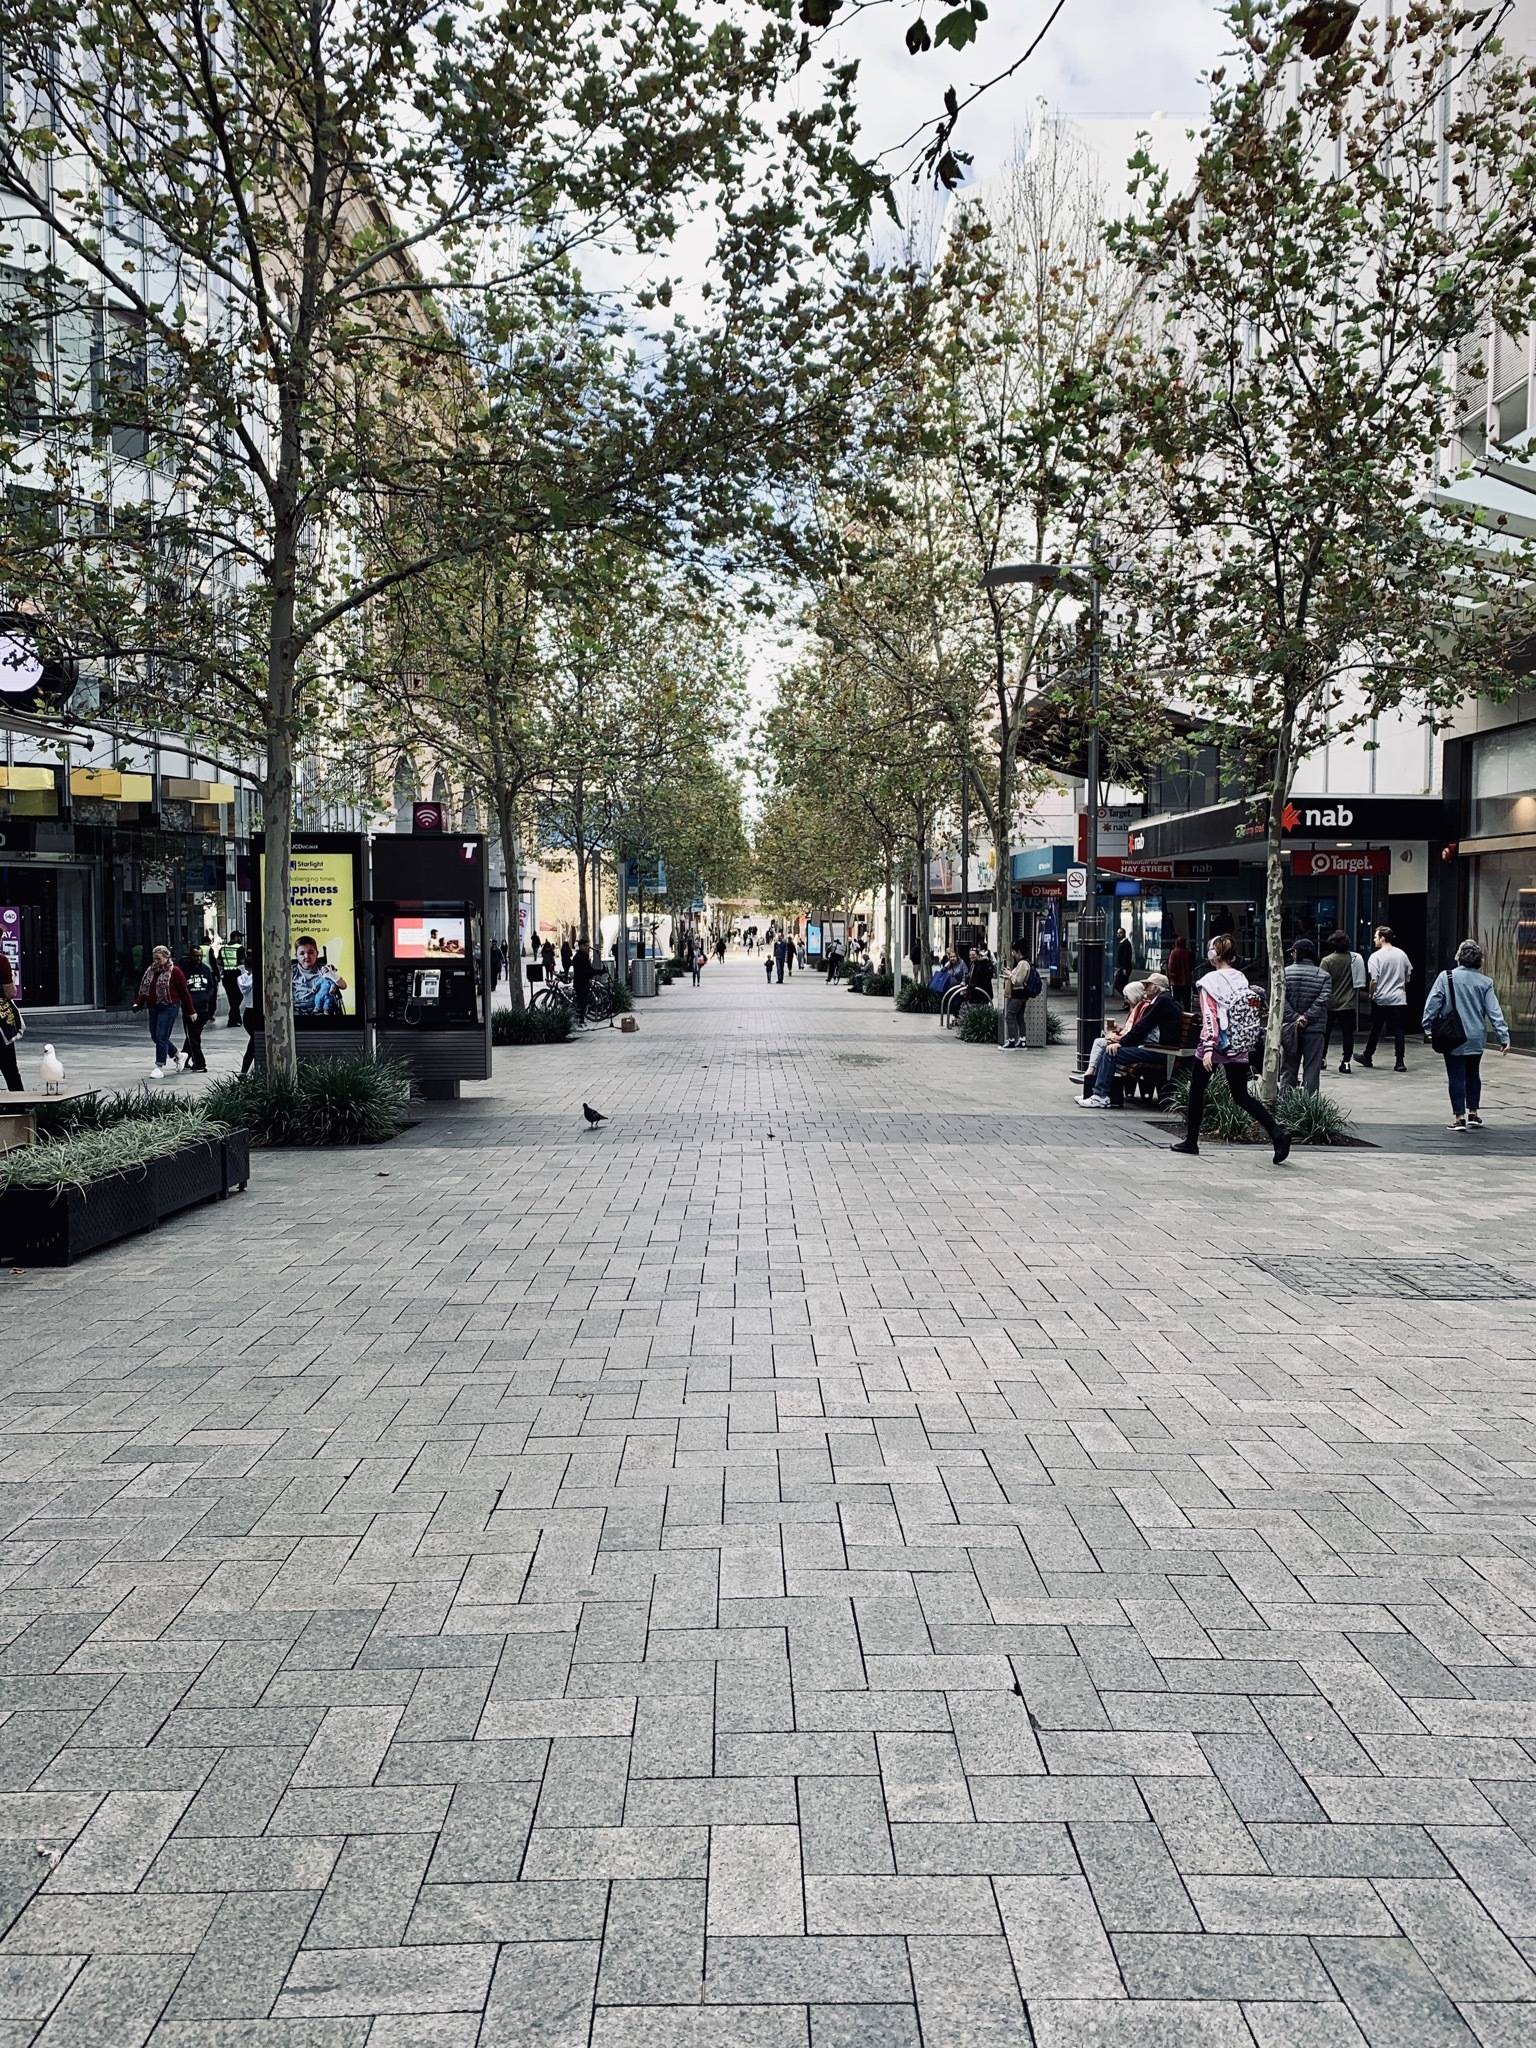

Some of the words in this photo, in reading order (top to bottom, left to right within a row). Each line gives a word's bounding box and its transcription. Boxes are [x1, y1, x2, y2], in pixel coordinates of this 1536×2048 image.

[1305, 804, 1353, 827] nab
[1113, 823, 1129, 831] nab
[1134, 832, 1145, 850] nab
[462, 842, 478, 859] T
[1121, 865, 1138, 873] HAY
[1140, 865, 1173, 873] STREET
[1192, 865, 1213, 873] nab
[1331, 855, 1373, 873] Target.
